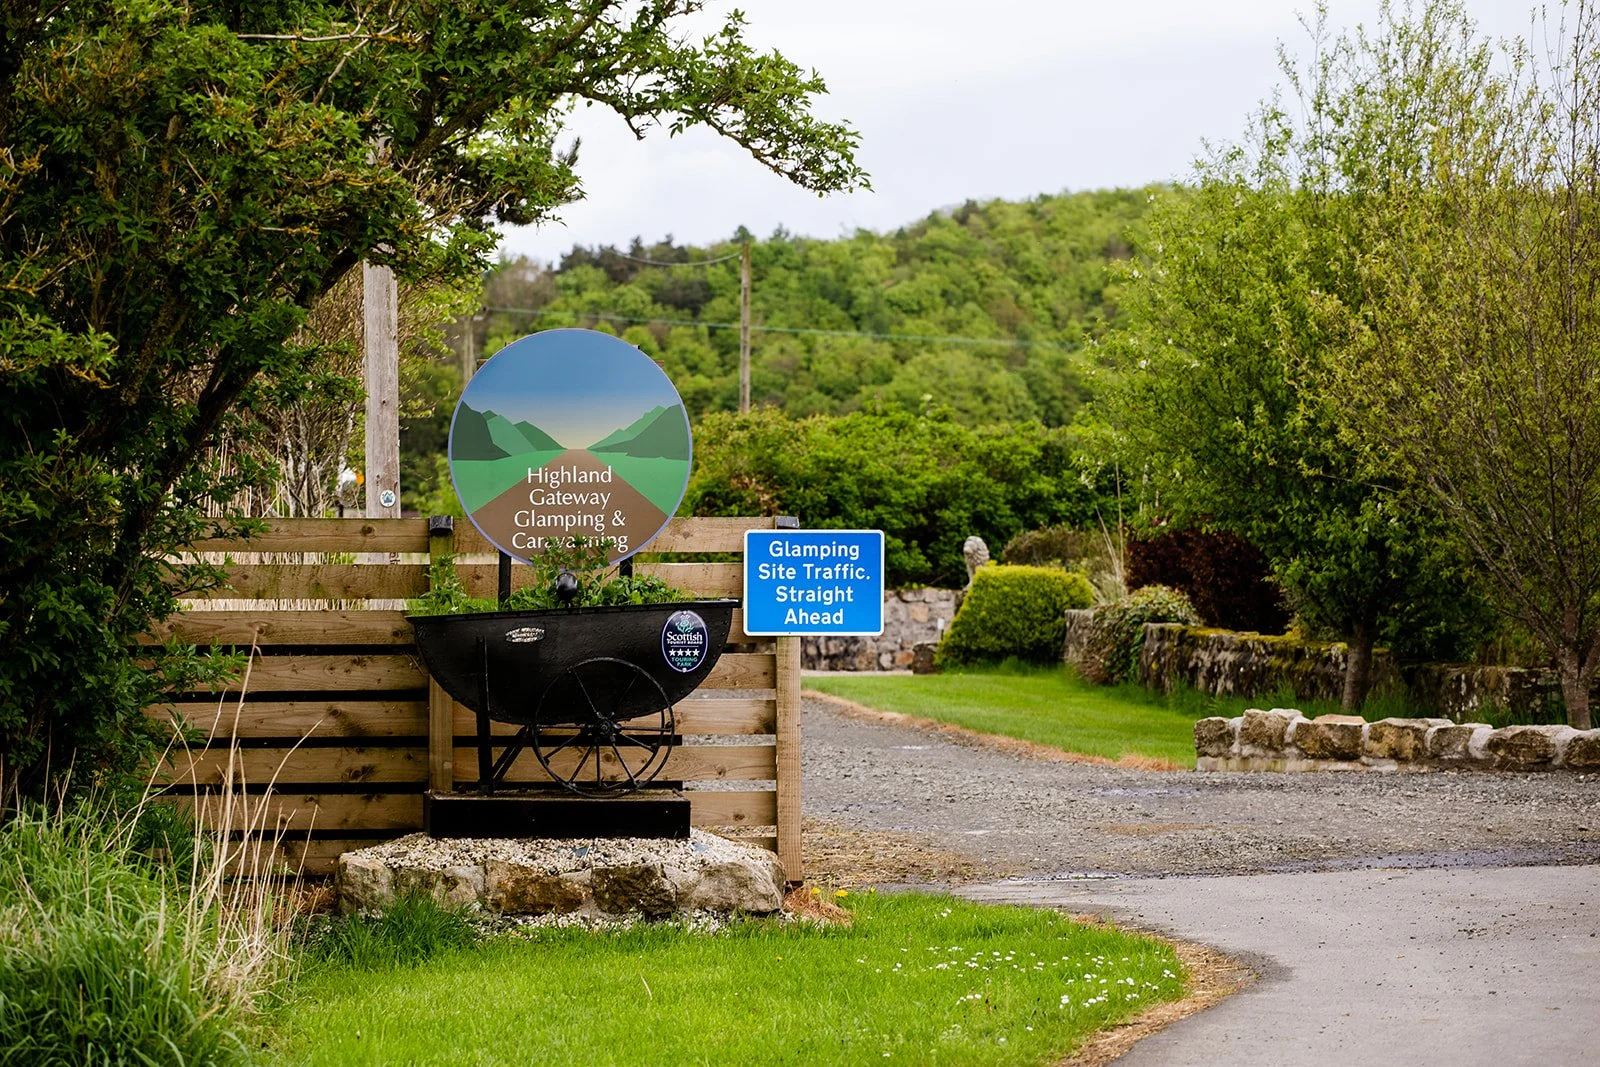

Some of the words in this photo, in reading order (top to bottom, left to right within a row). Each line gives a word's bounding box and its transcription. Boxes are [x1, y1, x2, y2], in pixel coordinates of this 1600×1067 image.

[527, 465, 612, 489] Highland
[529, 488, 611, 510] Gateway
[514, 510, 605, 532] Glamping
[612, 510, 626, 527] &
[769, 540, 860, 560] Glamping
[758, 563, 797, 580] Site
[802, 563, 871, 580] Traffic.
[775, 585, 854, 605] Straight
[784, 608, 844, 625] Ahead
[666, 631, 703, 641] Scottish
